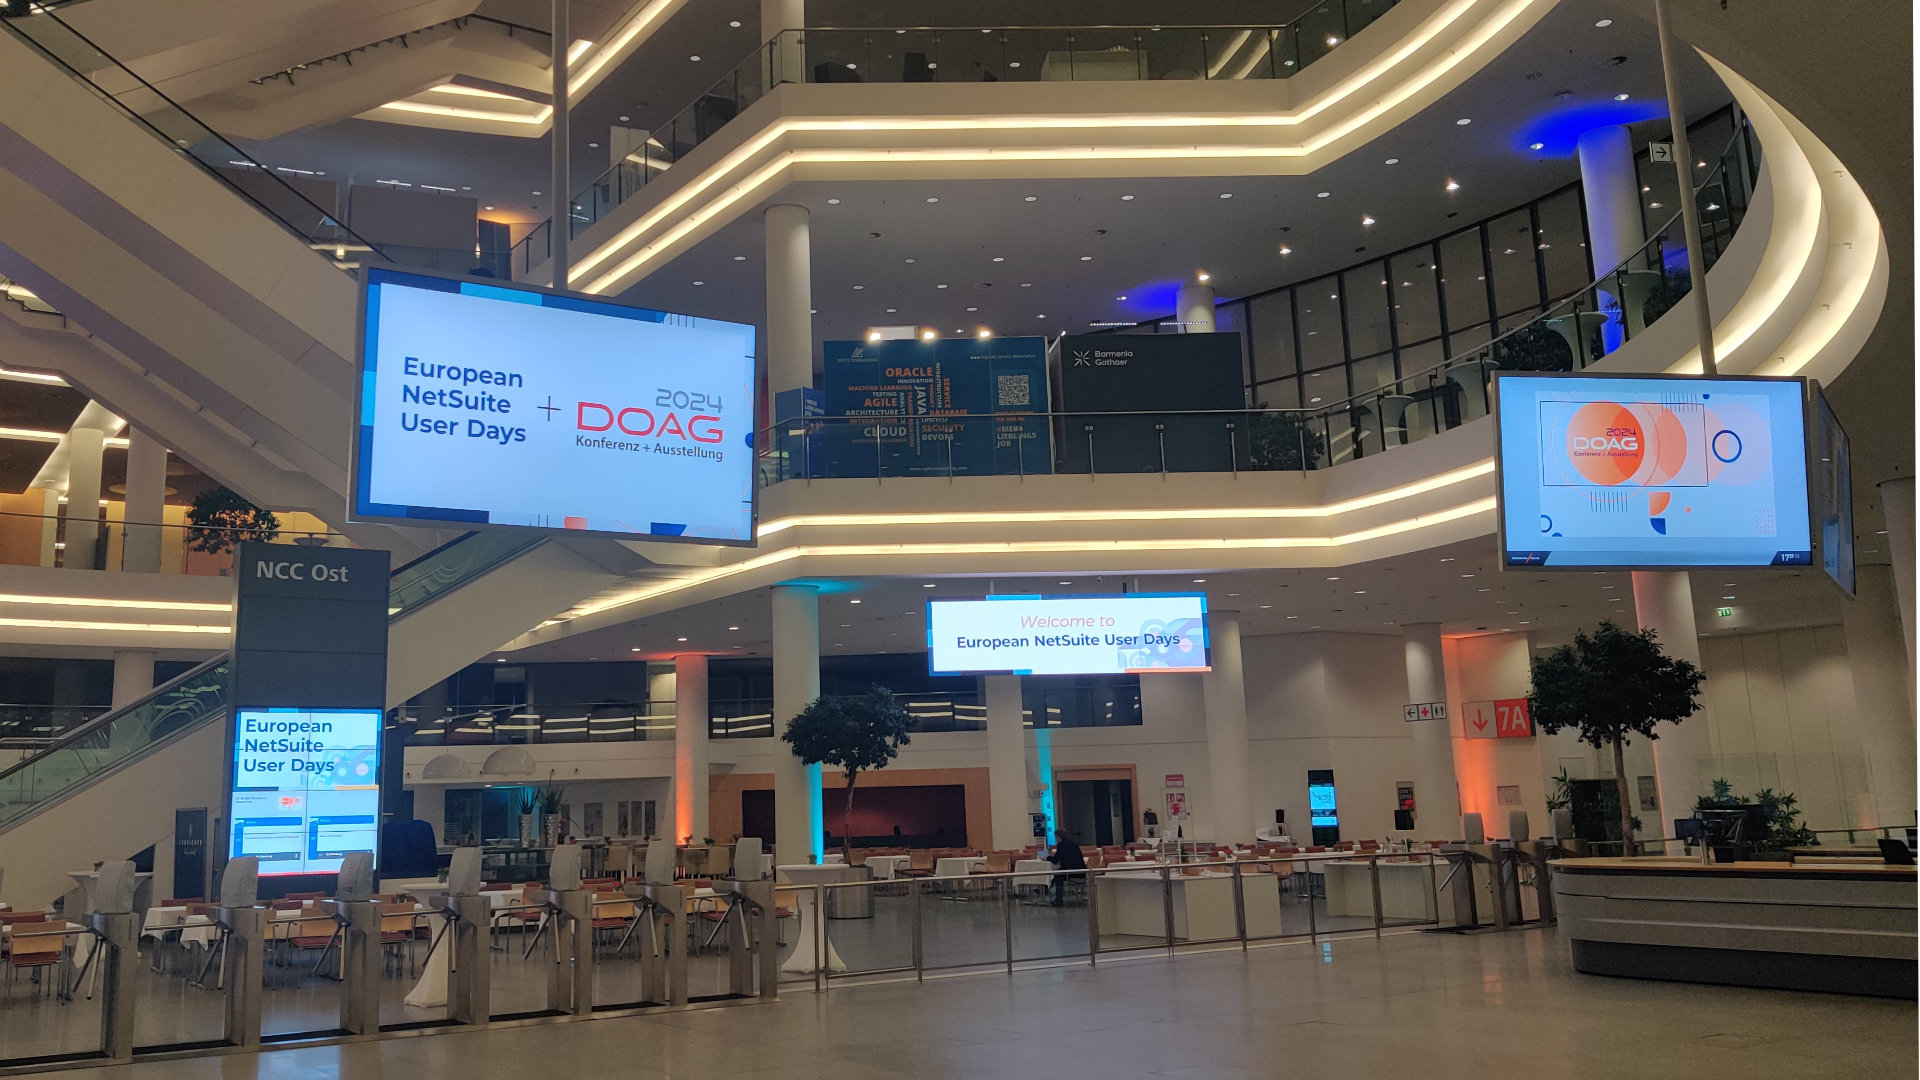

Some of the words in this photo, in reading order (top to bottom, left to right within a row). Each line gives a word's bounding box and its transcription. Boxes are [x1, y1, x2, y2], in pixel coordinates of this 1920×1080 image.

[1094, 350, 1133, 358] Barmenia
[1095, 358, 1128, 366] Gothaer
[404, 356, 523, 388] European
[886, 367, 933, 378] ORACLE
[402, 385, 511, 413] NetSuite
[655, 388, 723, 414] 2024
[864, 398, 898, 406] AGILE
[914, 385, 926, 414] JAVA
[401, 413, 459, 436] User
[467, 416, 526, 445] Days
[577, 402, 724, 444] DOAG
[864, 427, 907, 437] CLOUD
[1606, 428, 1636, 436] 2024
[576, 436, 640, 452] Konferenz
[654, 444, 723, 462] Ausstellung
[997, 440, 1011, 448] JOB
[1574, 437, 1638, 450] DOAG
[256, 560, 304, 581] NCC
[311, 563, 349, 583] Ost
[1020, 616, 1094, 629] Welcome
[1099, 616, 1115, 628] to
[957, 636, 1029, 650] European
[1034, 634, 1100, 647] NetSuite
[1105, 634, 1138, 646] User
[1144, 633, 1180, 648] Days
[1498, 706, 1527, 731] 7A
[246, 719, 332, 736] European
[244, 738, 324, 753] NetSuite
[244, 758, 285, 772] User
[291, 758, 334, 775] Days
